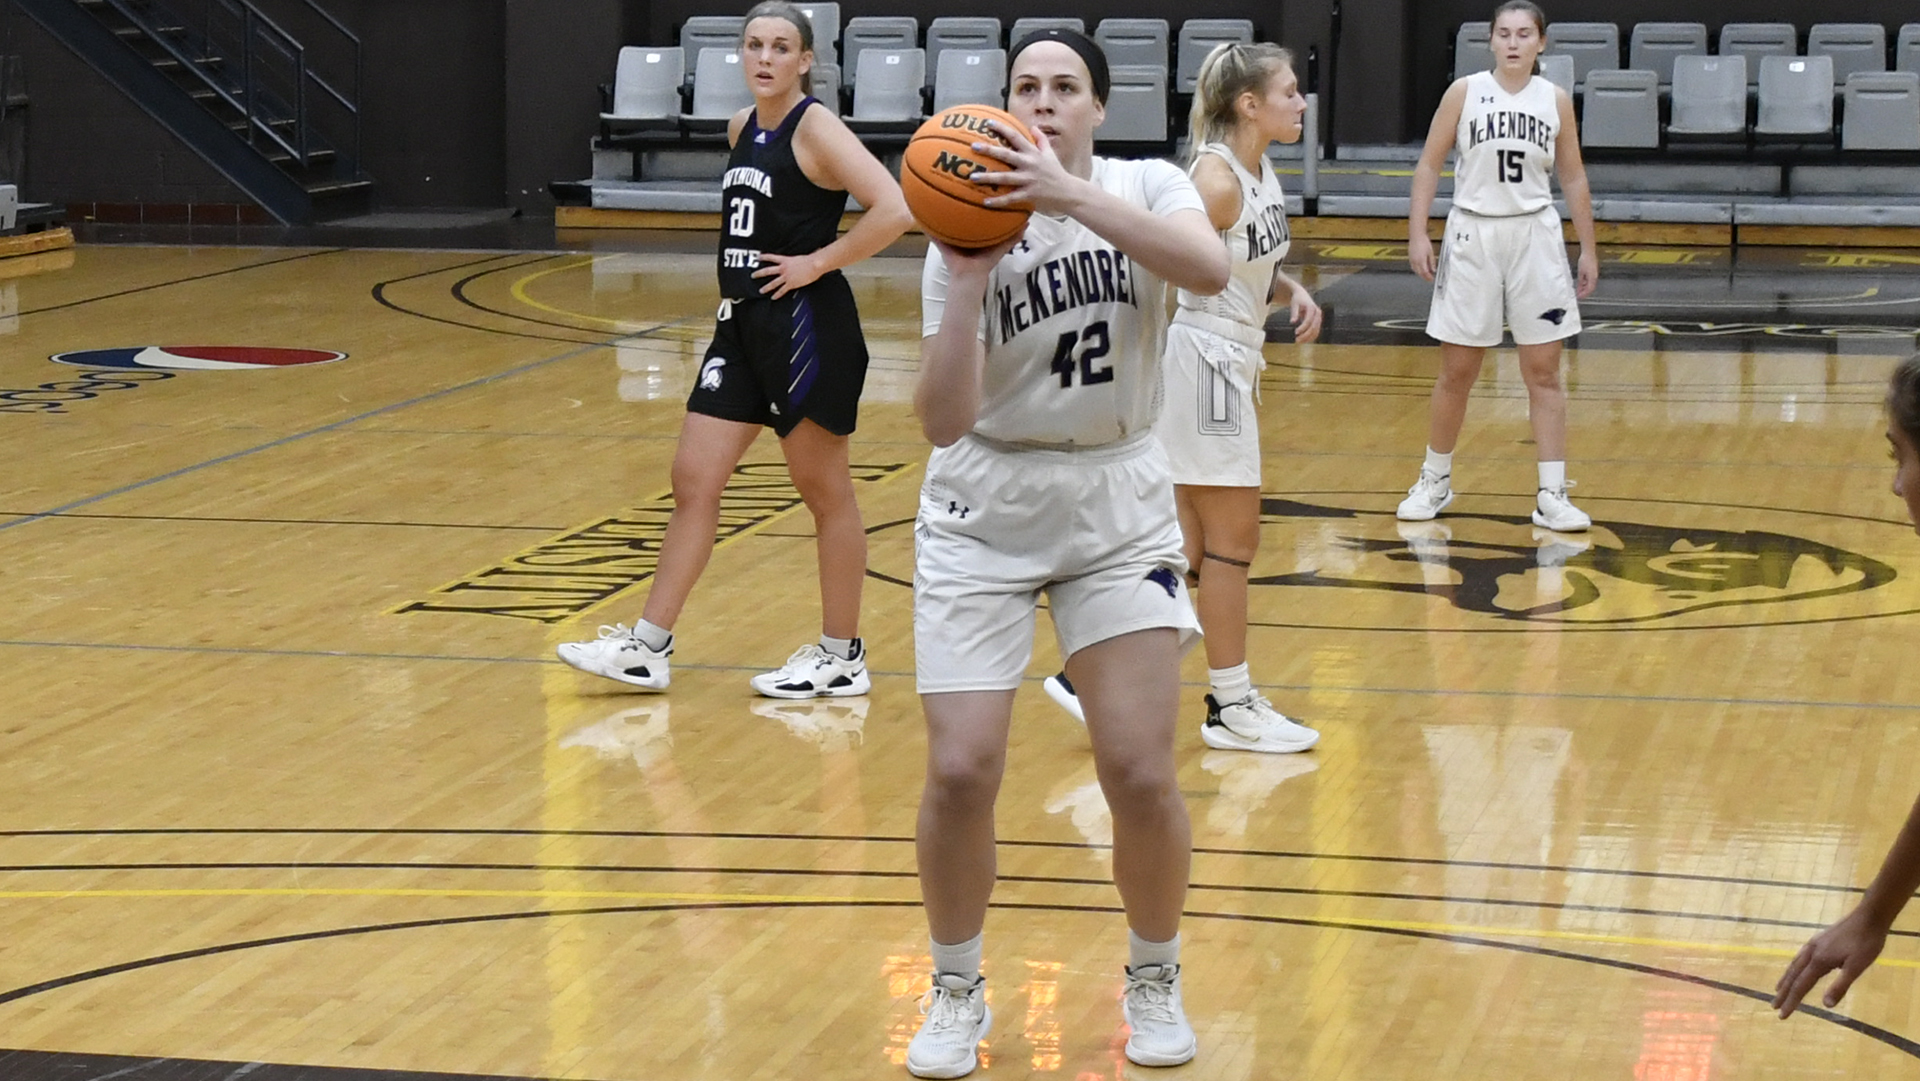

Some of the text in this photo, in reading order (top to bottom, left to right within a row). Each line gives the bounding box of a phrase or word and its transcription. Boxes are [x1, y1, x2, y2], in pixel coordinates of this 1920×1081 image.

[1469, 111, 1552, 154] McKENDREE
[722, 166, 773, 198] WINONA
[1497, 149, 1526, 183] 15
[729, 197, 756, 238] 20
[1051, 320, 1114, 389] 42
